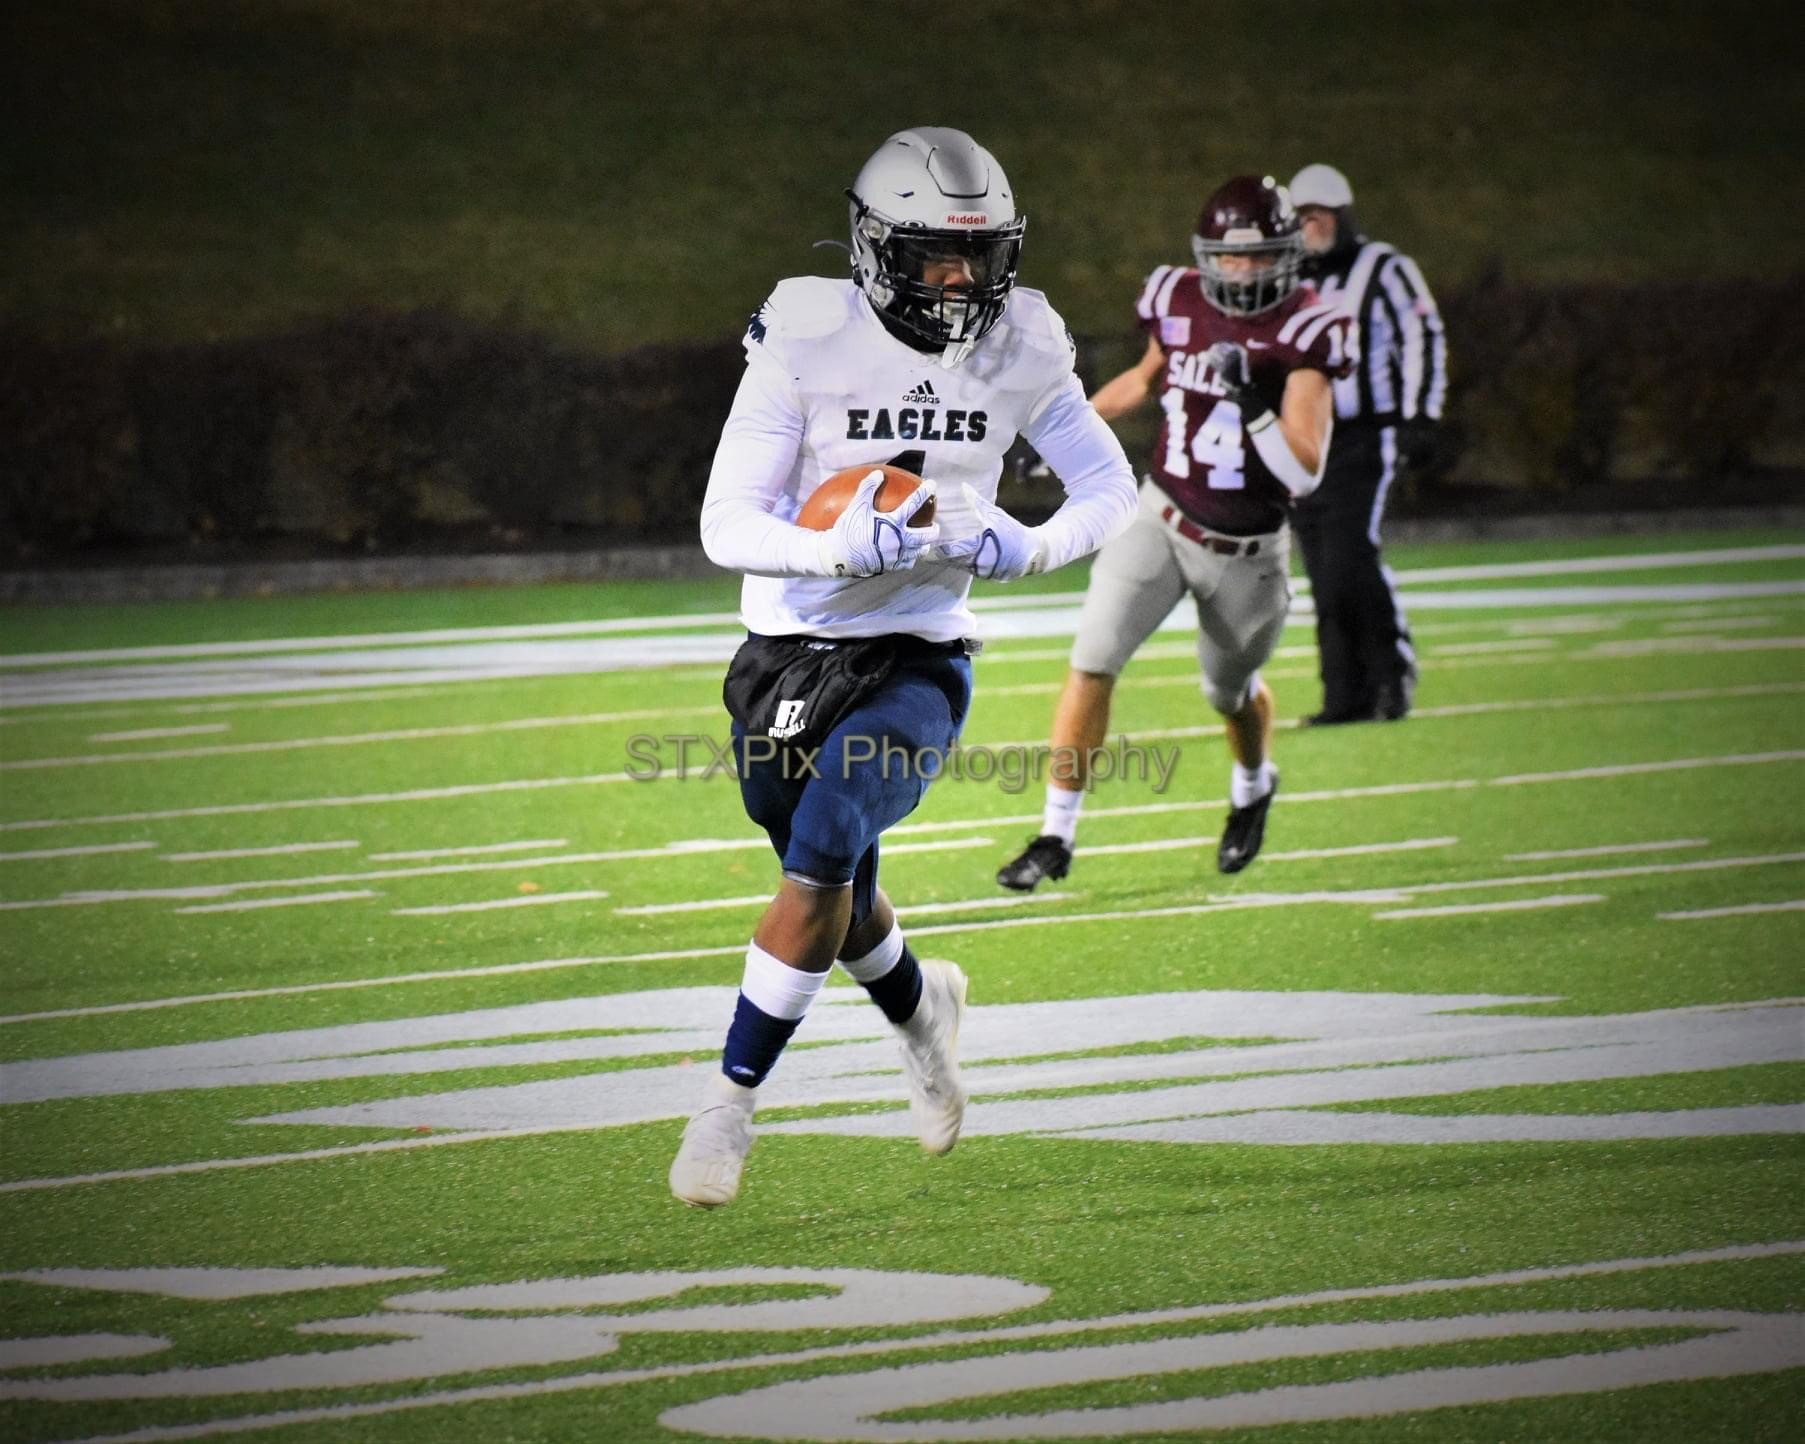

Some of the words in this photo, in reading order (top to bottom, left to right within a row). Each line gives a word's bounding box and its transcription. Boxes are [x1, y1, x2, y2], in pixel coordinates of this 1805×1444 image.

[946, 214, 987, 225] Riddell
[902, 393, 941, 405] adidas
[846, 408, 988, 443] EAGLES
[1160, 386, 1246, 489] 14
